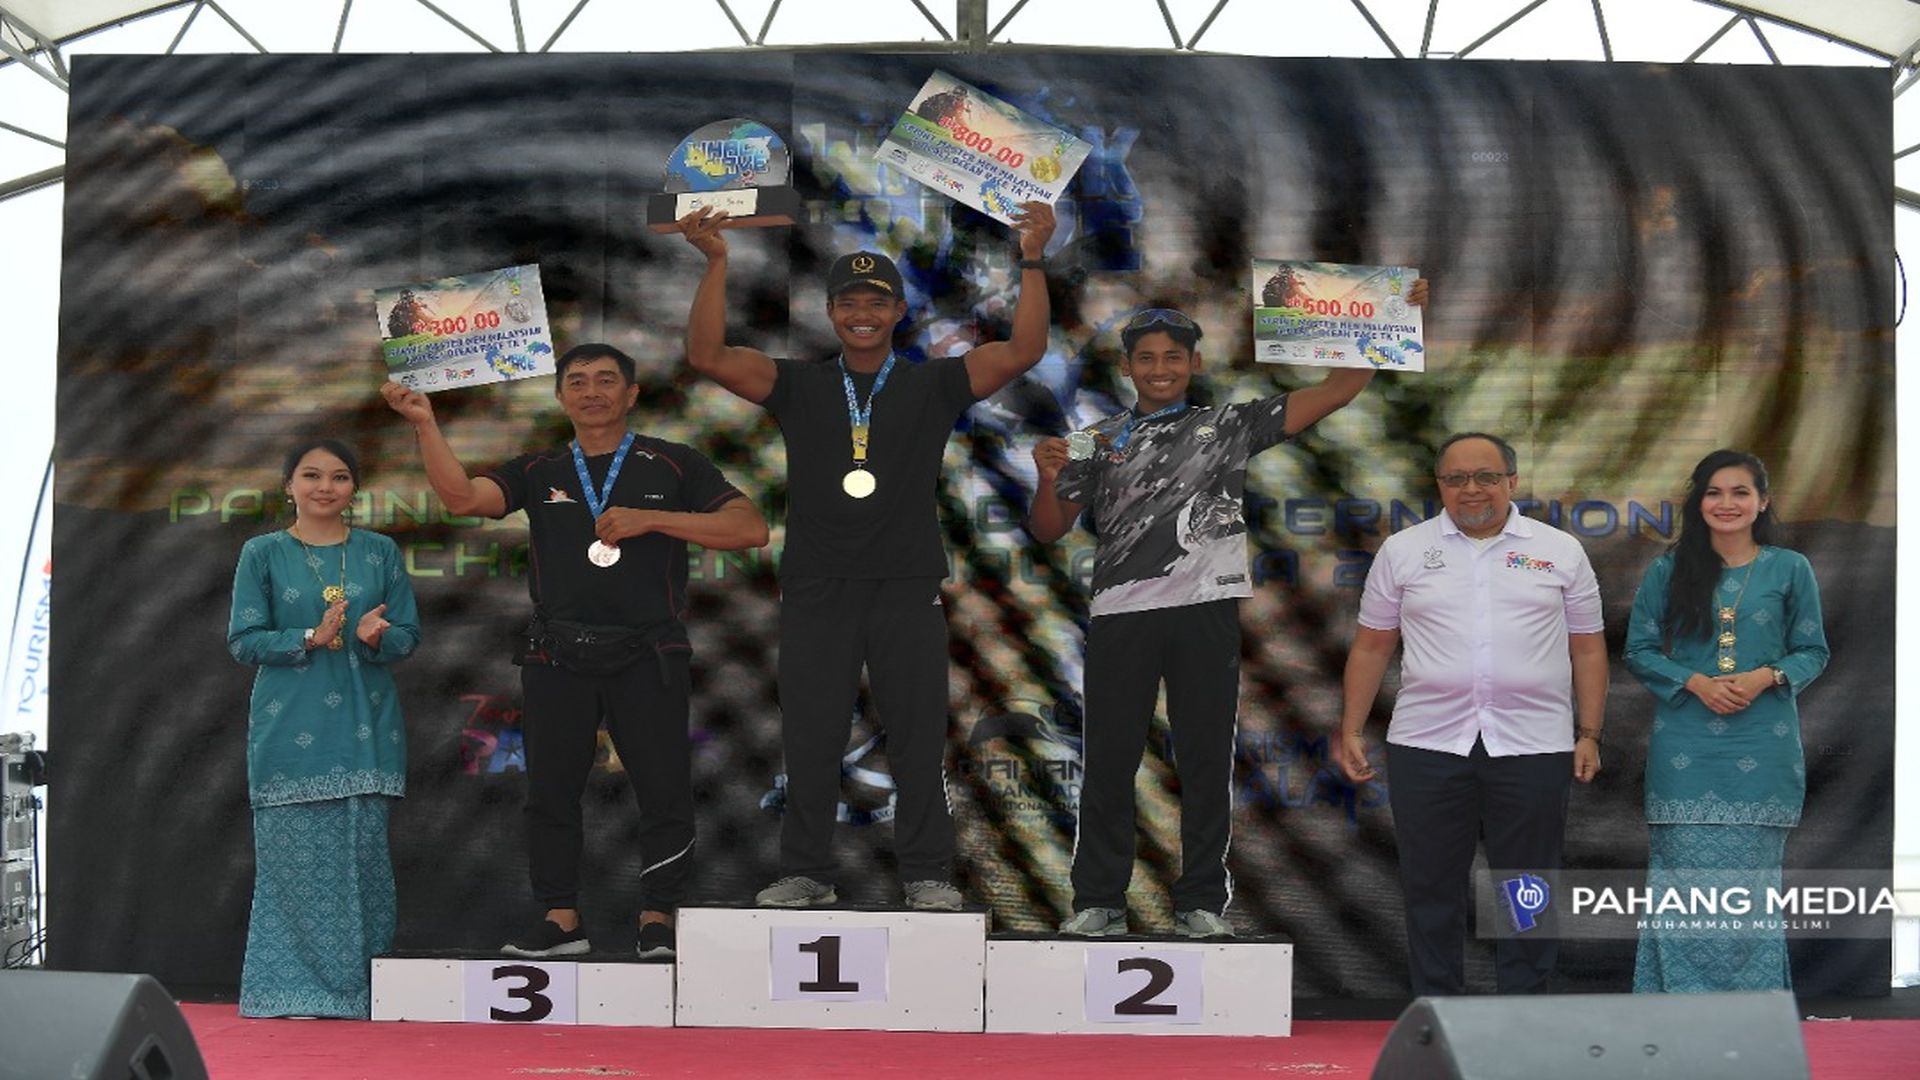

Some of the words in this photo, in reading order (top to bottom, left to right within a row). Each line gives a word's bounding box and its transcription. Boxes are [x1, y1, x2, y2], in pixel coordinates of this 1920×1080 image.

[952, 156, 984, 175] OCEAN
[976, 159, 998, 172] MEN
[998, 169, 1053, 200] MALAYSIAN
[1363, 322, 1416, 333] MALAYSIAN
[799, 936, 859, 992] 1
[1114, 957, 1177, 1015] 2
[490, 965, 553, 1022] 3
